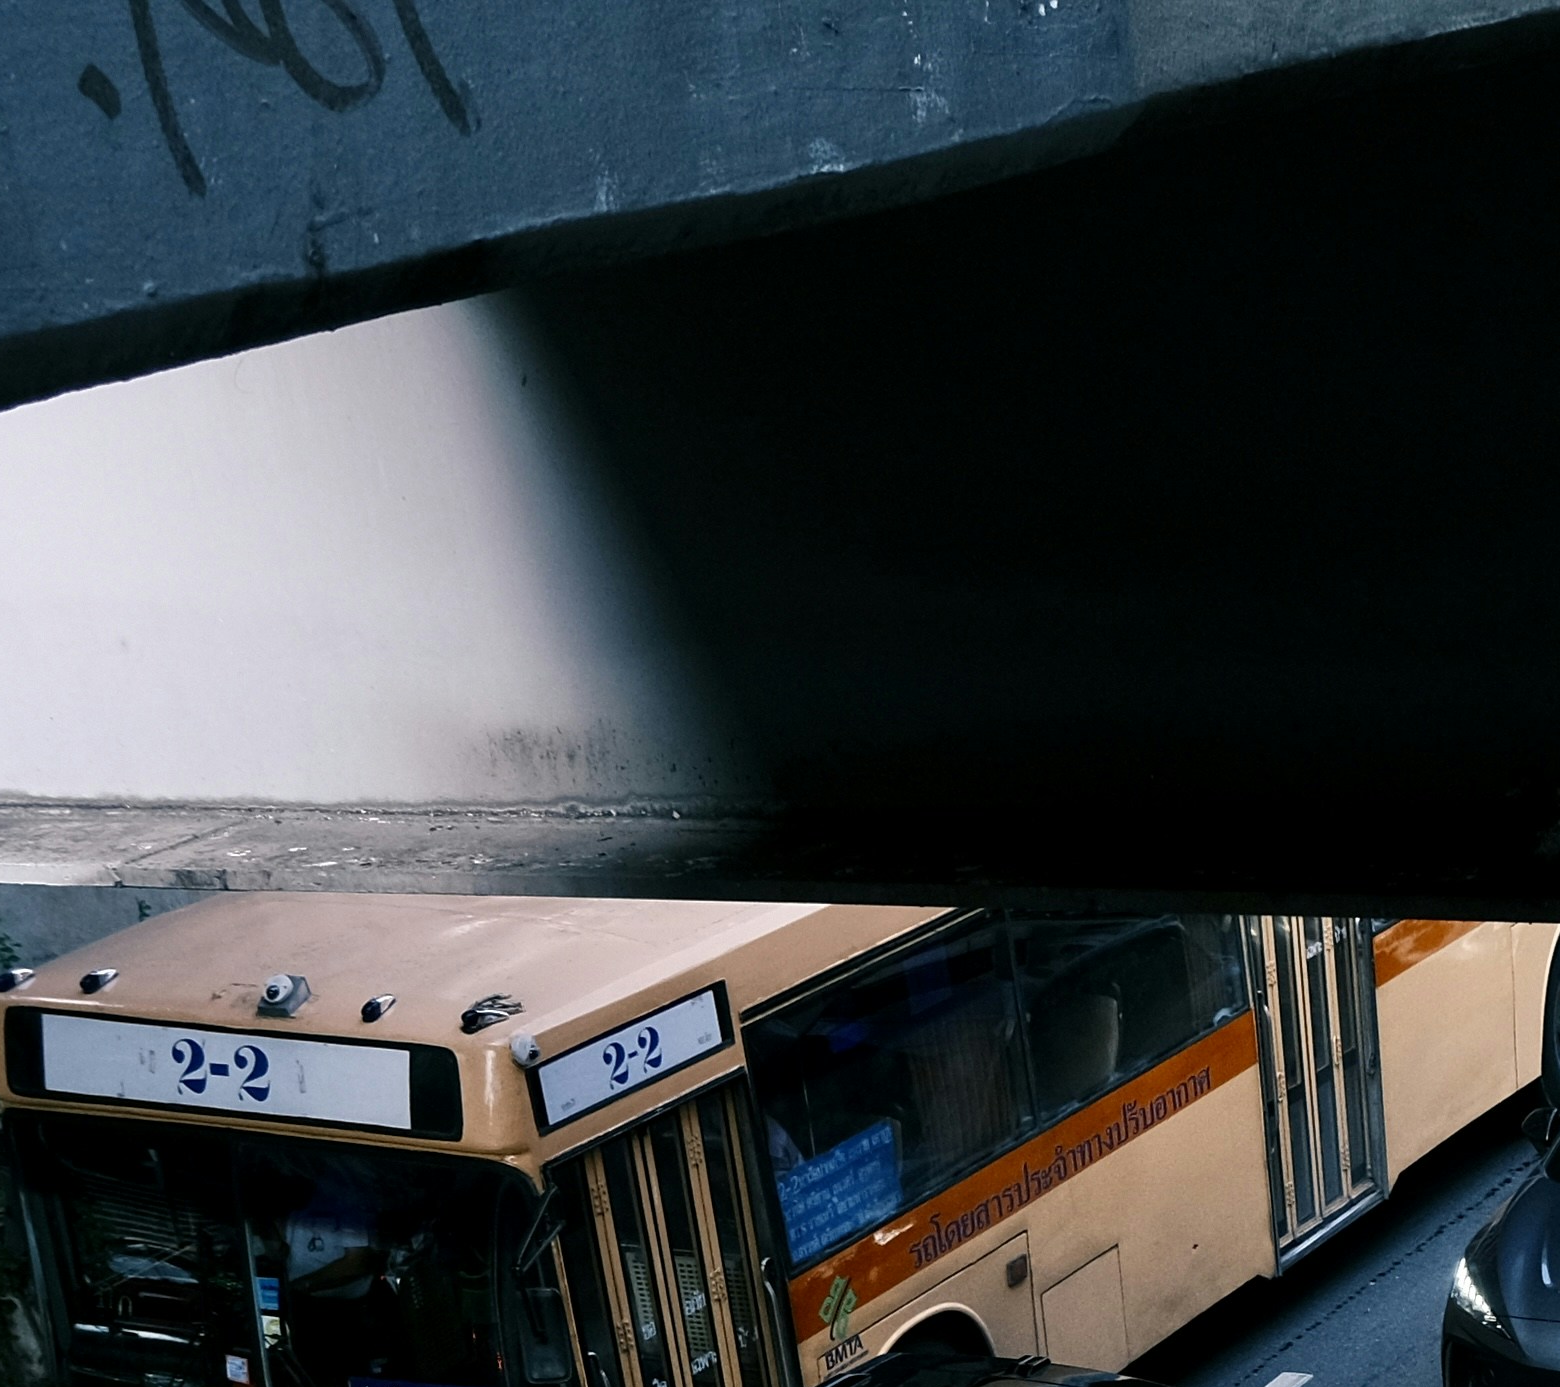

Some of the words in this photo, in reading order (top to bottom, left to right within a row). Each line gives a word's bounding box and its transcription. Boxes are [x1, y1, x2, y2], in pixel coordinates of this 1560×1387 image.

[171, 1037, 271, 1102] 2-2
[602, 1025, 663, 1091] 2-2
[908, 1065, 1212, 1269] รถโดยสารประจำทางปรับอากาศ
[824, 1334, 865, 1371] BMTA
